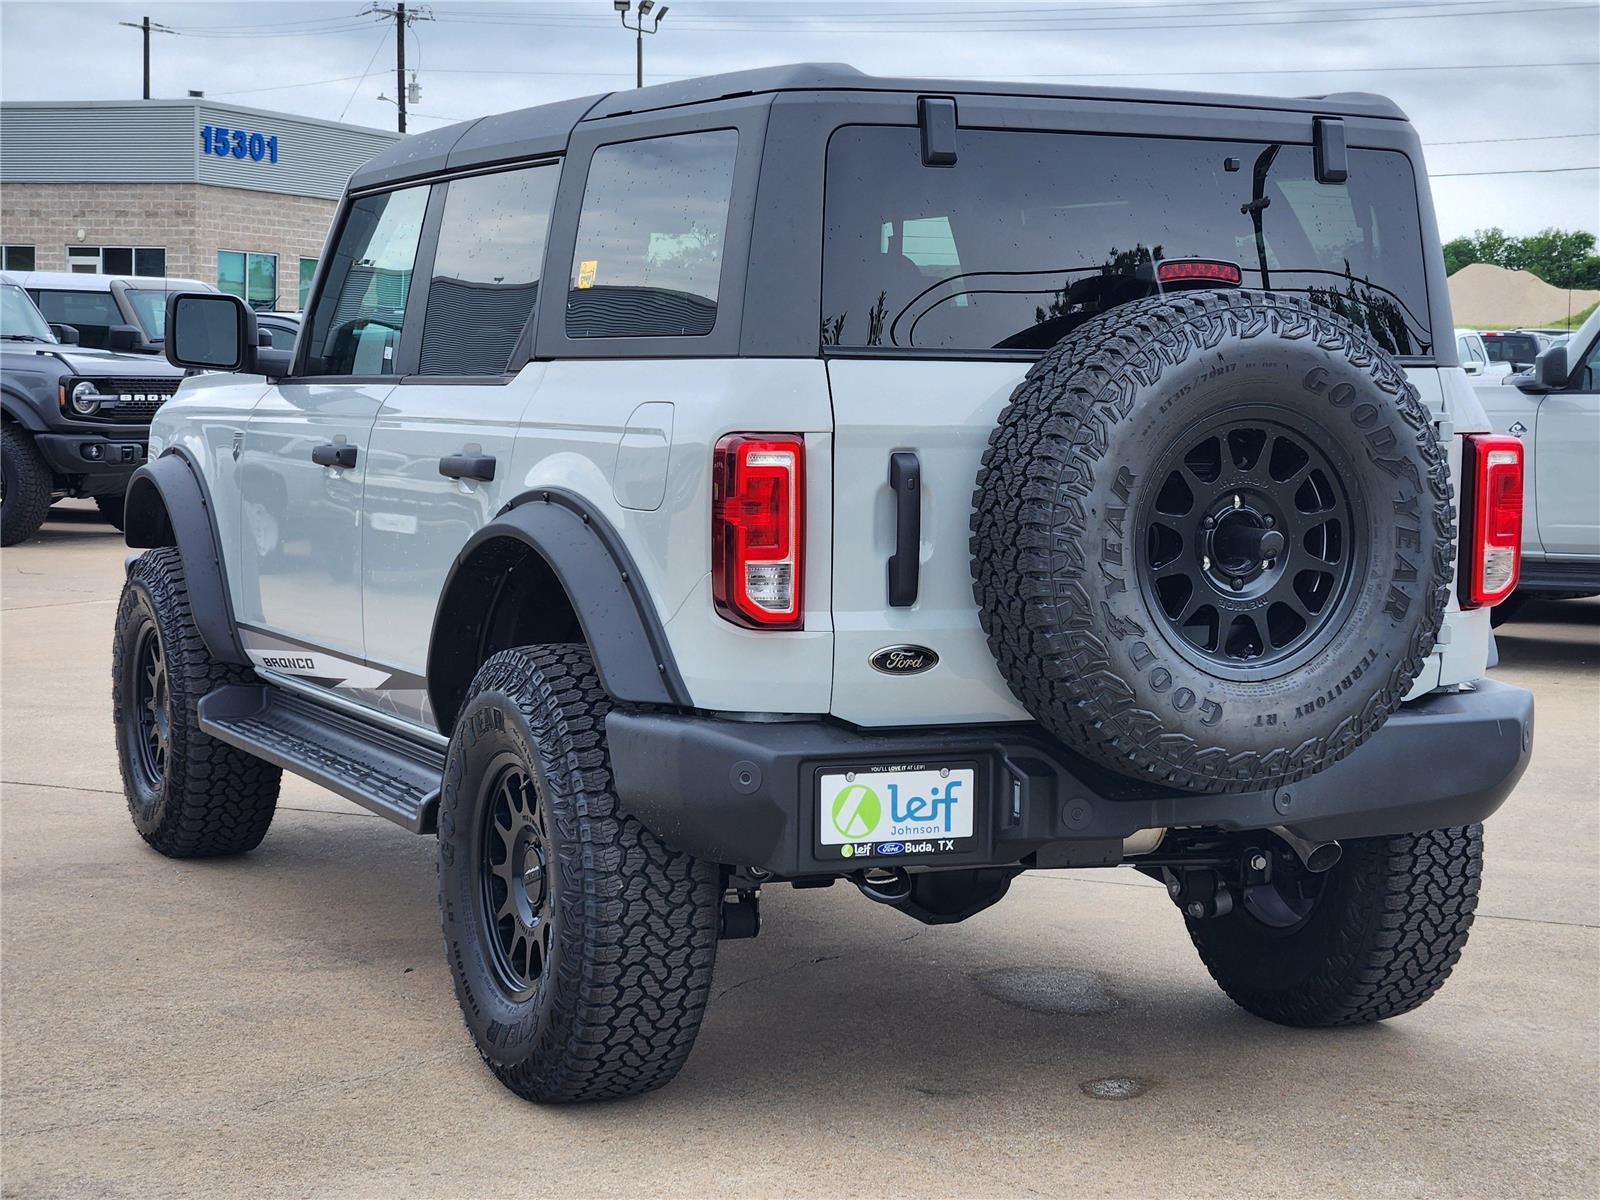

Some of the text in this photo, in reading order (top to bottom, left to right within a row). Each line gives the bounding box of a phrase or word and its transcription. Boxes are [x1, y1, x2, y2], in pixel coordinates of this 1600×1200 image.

[200, 125, 278, 164] 15301
[262, 656, 316, 670] BRONCO
[886, 651, 924, 669] Ford
[1253, 649, 1378, 727] TERRITORY RT
[887, 780, 962, 832] leif
[891, 825, 940, 836] Johnson
[854, 843, 873, 857] leif
[881, 845, 901, 853] Ford
[905, 842, 935, 854] Buda,
[938, 840, 954, 851] TX
